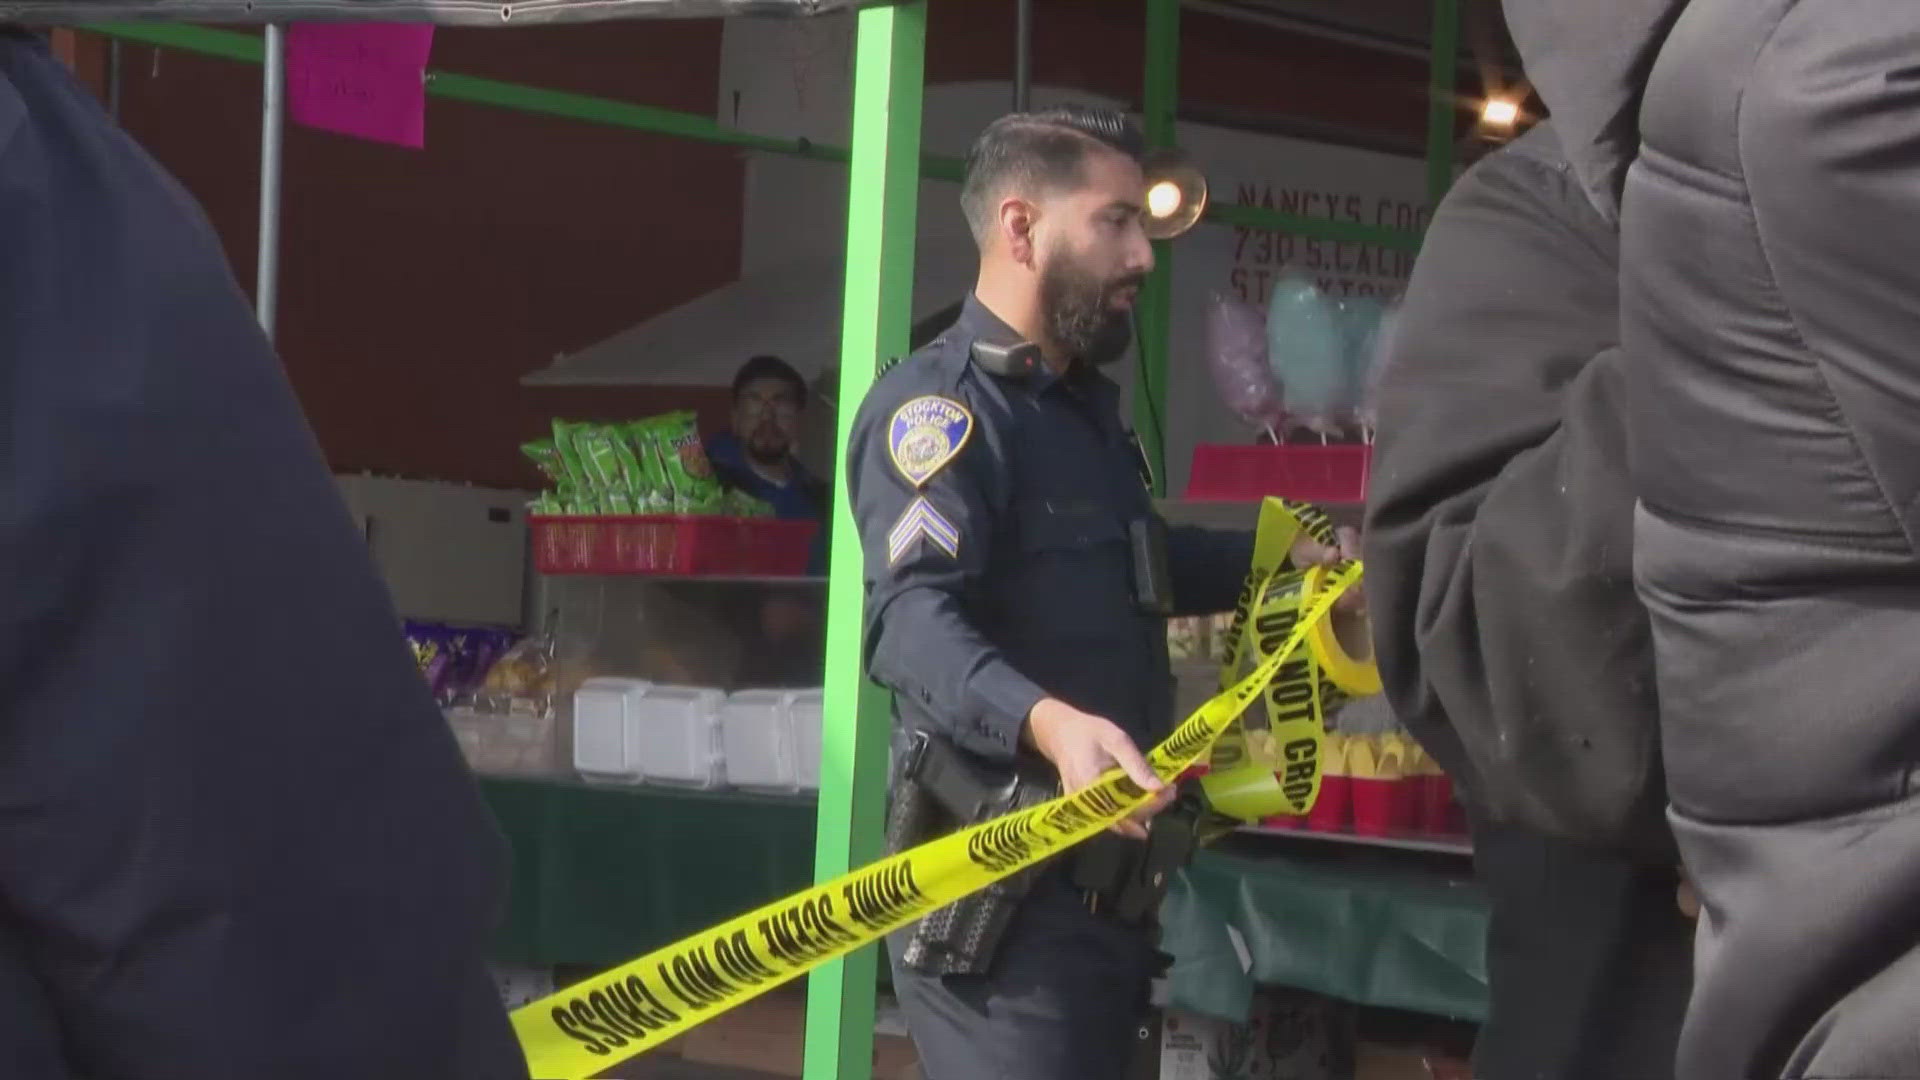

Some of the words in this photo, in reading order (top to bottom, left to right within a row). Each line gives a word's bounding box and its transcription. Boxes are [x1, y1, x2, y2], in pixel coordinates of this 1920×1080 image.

[1236, 182, 1361, 223] NANCYS
[900, 401, 964, 424] STOCKTON
[906, 413, 950, 431] POLICE
[1270, 659, 1315, 722] NOT
[714, 929, 783, 986] DO
[757, 893, 861, 967] SCENE
[657, 946, 743, 1010] NOT
[551, 974, 682, 1056] CROSS
